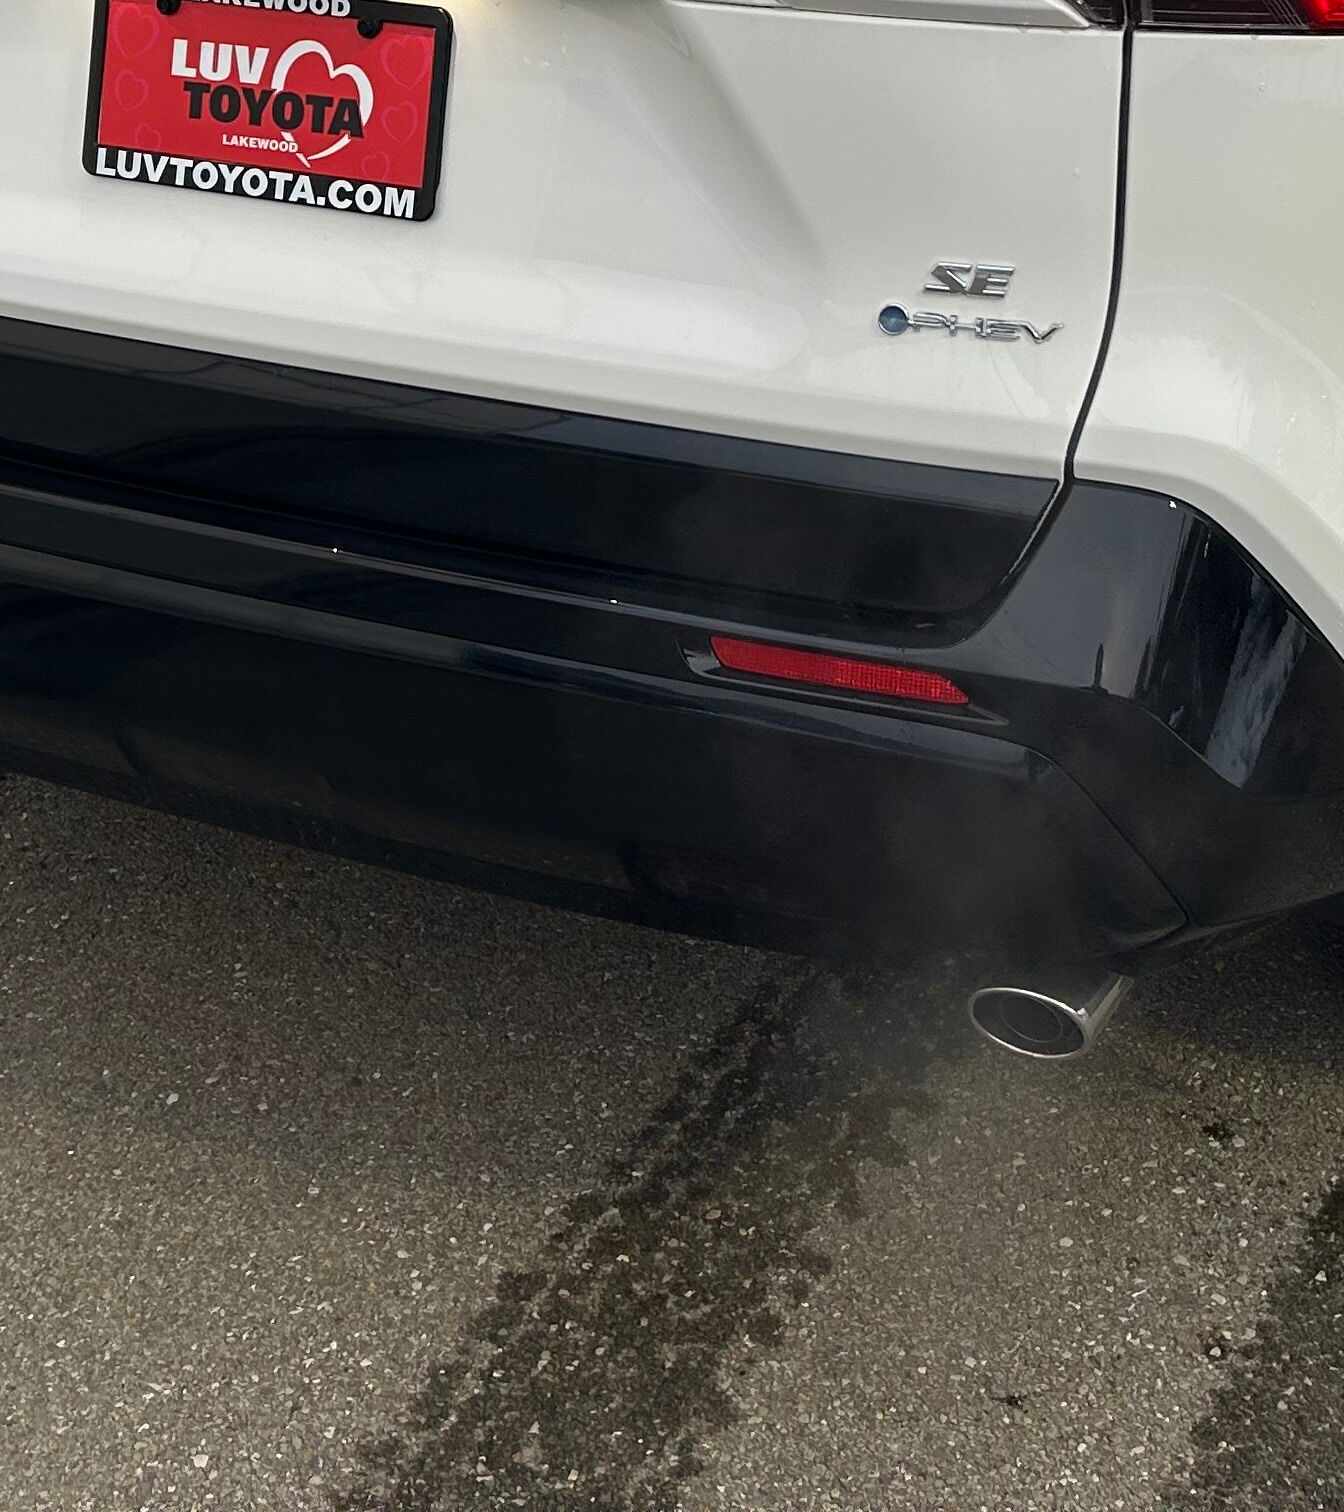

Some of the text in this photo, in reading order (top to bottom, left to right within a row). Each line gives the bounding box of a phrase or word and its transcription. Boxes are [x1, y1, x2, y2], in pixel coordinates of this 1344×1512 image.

[171, 38, 270, 85] LUV
[183, 81, 364, 138] TOYOTA
[222, 134, 299, 154] LAKEWOOD
[95, 147, 416, 219] LUVTOYOTA.COM
[923, 261, 1016, 298] SE
[911, 311, 1065, 345] PHEV
